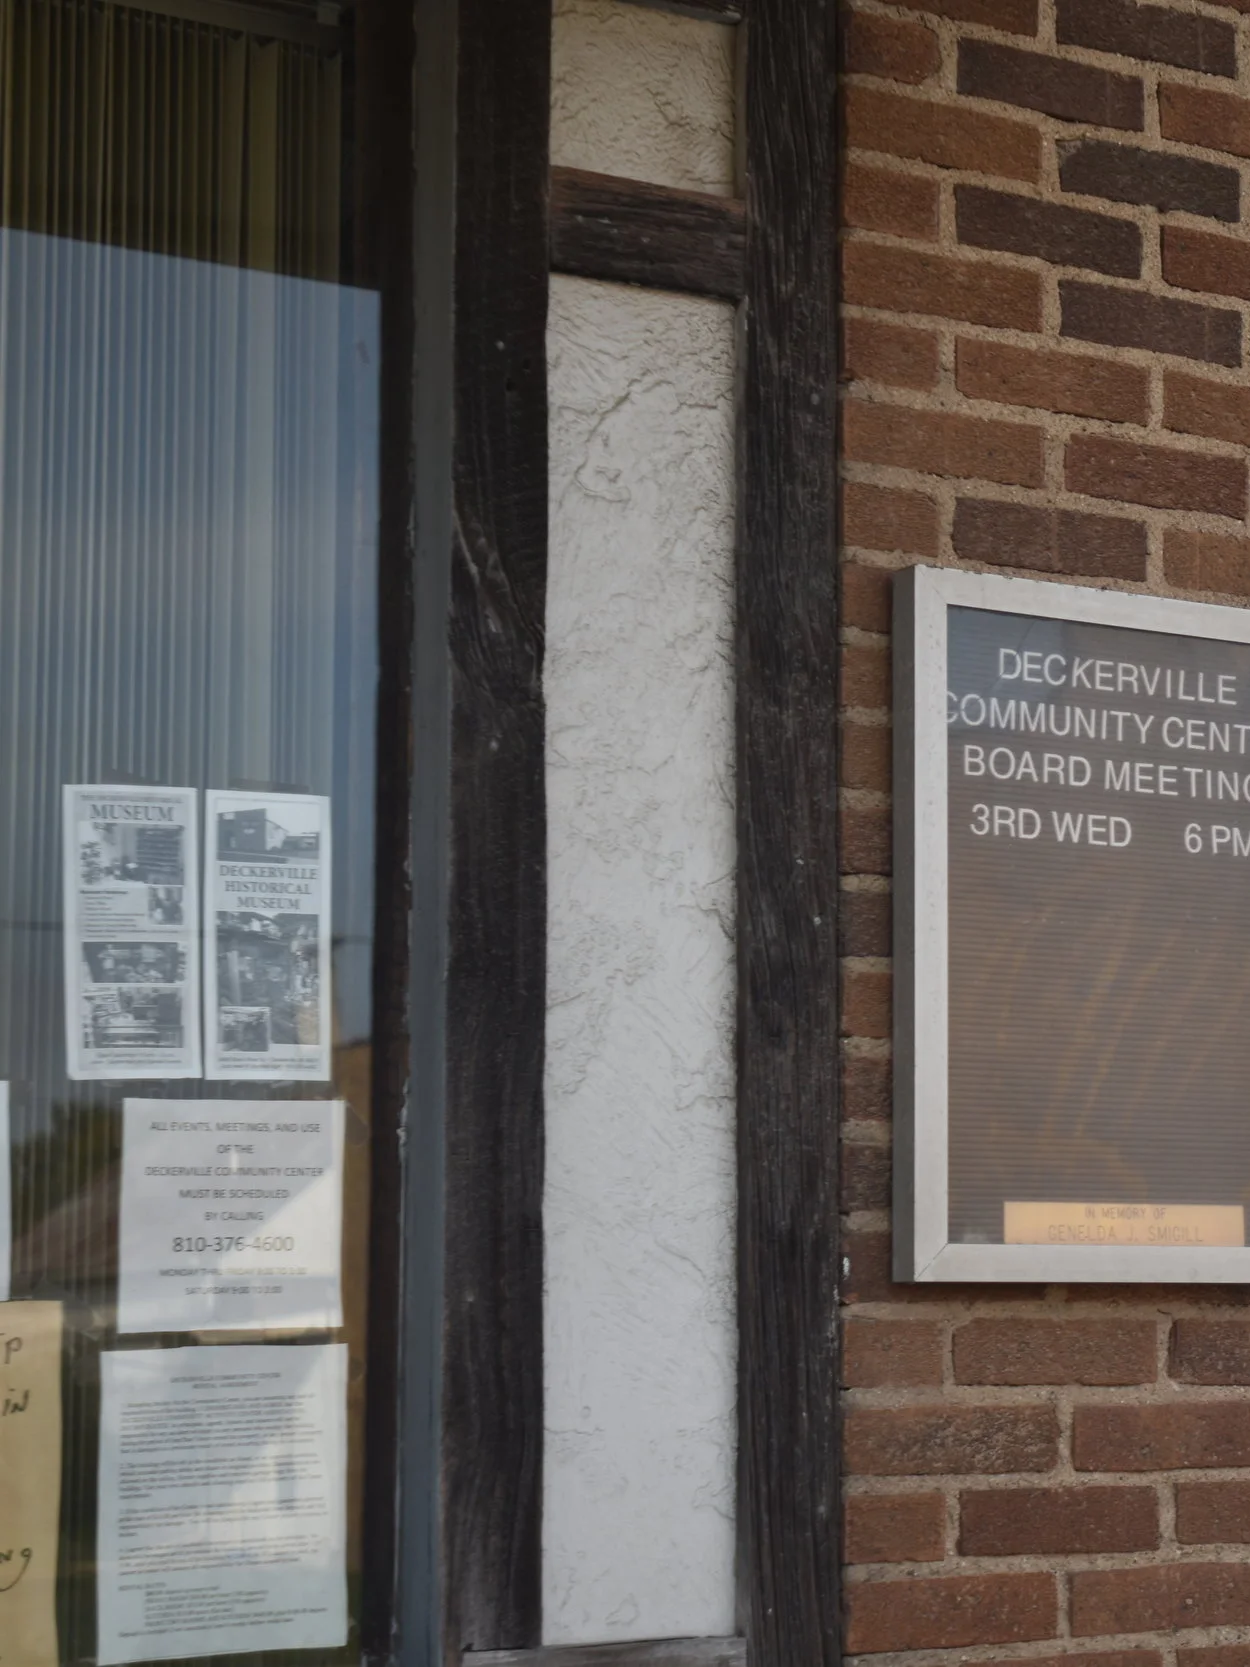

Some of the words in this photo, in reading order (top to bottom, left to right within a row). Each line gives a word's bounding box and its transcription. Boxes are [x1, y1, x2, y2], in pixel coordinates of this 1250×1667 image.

[998, 647, 1238, 706] DECKERVILLE
[962, 744, 1092, 788] BOARD
[89, 803, 174, 822] MUSEUM
[969, 803, 1042, 840] 3RD
[1052, 811, 1132, 848] WED
[1183, 823, 1203, 854] 6
[219, 864, 319, 880] DECKERVILLE
[224, 880, 311, 895] HISTORICAL
[236, 895, 300, 910] MUSEUM
[149, 1122, 169, 1132] ALL
[275, 1122, 298, 1133] AND
[300, 1123, 321, 1133] USE
[216, 1144, 231, 1154] OF
[233, 1144, 255, 1154] THE
[144, 1166, 213, 1177] DECKERVILLE
[284, 1167, 325, 1178] CENTER
[178, 1189, 211, 1199] MUST
[212, 1189, 226, 1199] BE
[228, 1189, 290, 1199] SCHEDULED
[204, 1211, 218, 1221] BY
[219, 1211, 264, 1221] CALLING
[1085, 1206, 1097, 1219] IN
[1101, 1207, 1147, 1220] MEMORY
[1153, 1207, 1168, 1220] OF
[1047, 1223, 1118, 1243] GENELDA
[171, 1236, 295, 1253] 810-376-4600
